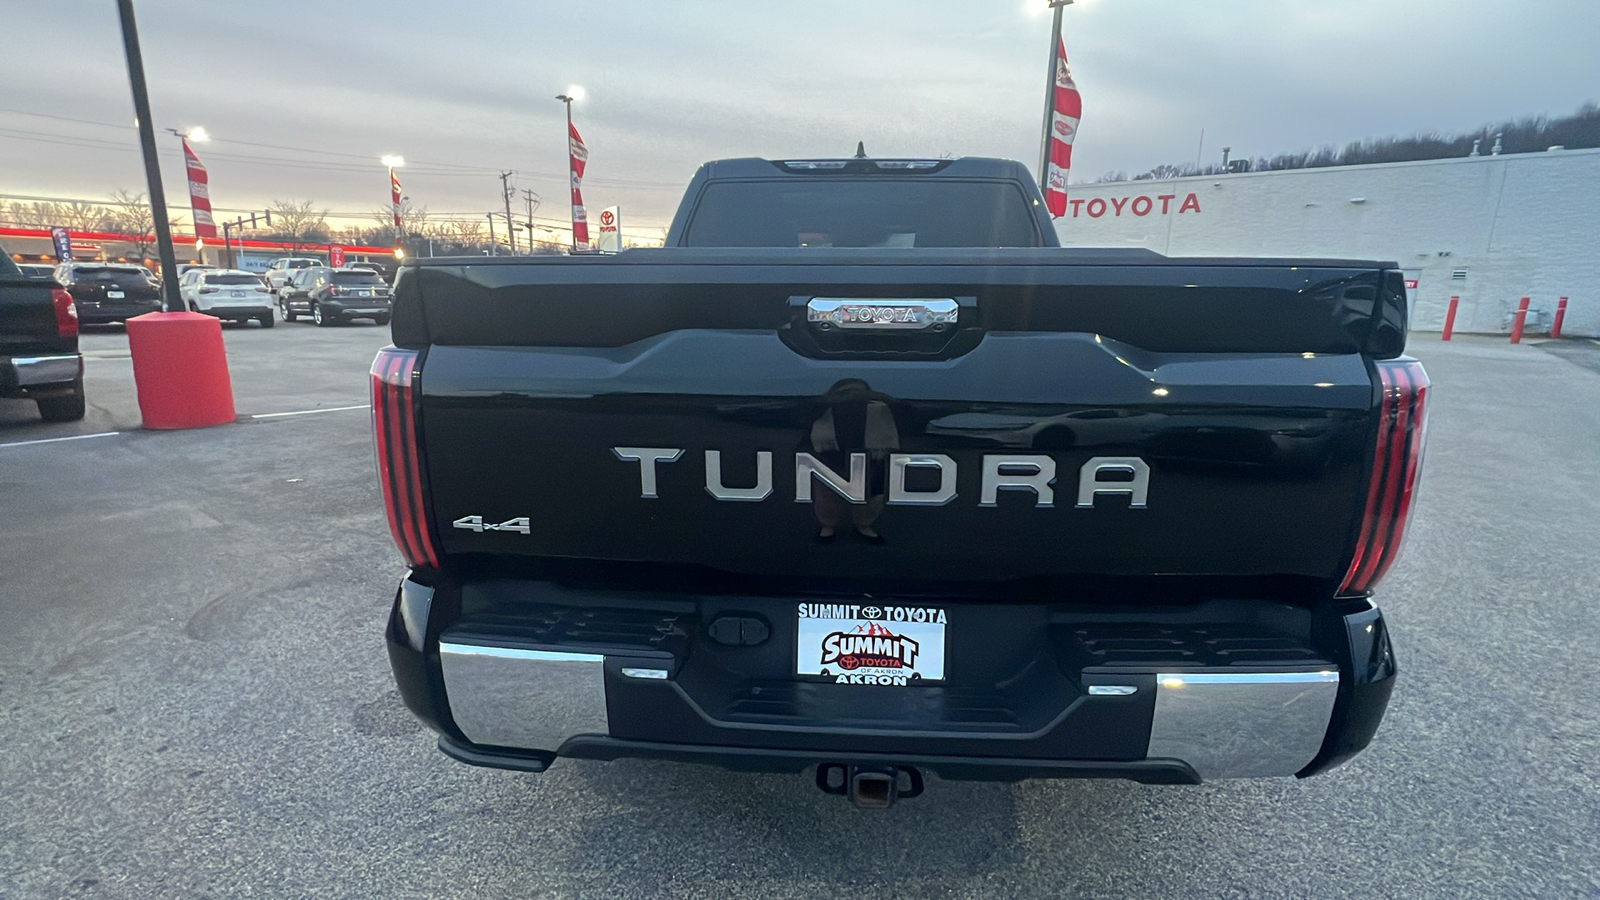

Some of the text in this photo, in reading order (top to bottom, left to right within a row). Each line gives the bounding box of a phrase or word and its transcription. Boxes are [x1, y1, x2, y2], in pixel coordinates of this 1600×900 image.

[1069, 193, 1201, 218] TOYOTA
[848, 307, 918, 322] TOYOTA
[610, 446, 1150, 509] TUNDRA
[453, 515, 531, 534] 4x4
[798, 603, 948, 624] SUMMIT TOYOTA
[822, 633, 918, 667] SUMMIT
[860, 657, 901, 668] TOYOTA
[835, 674, 908, 687] AKRON
